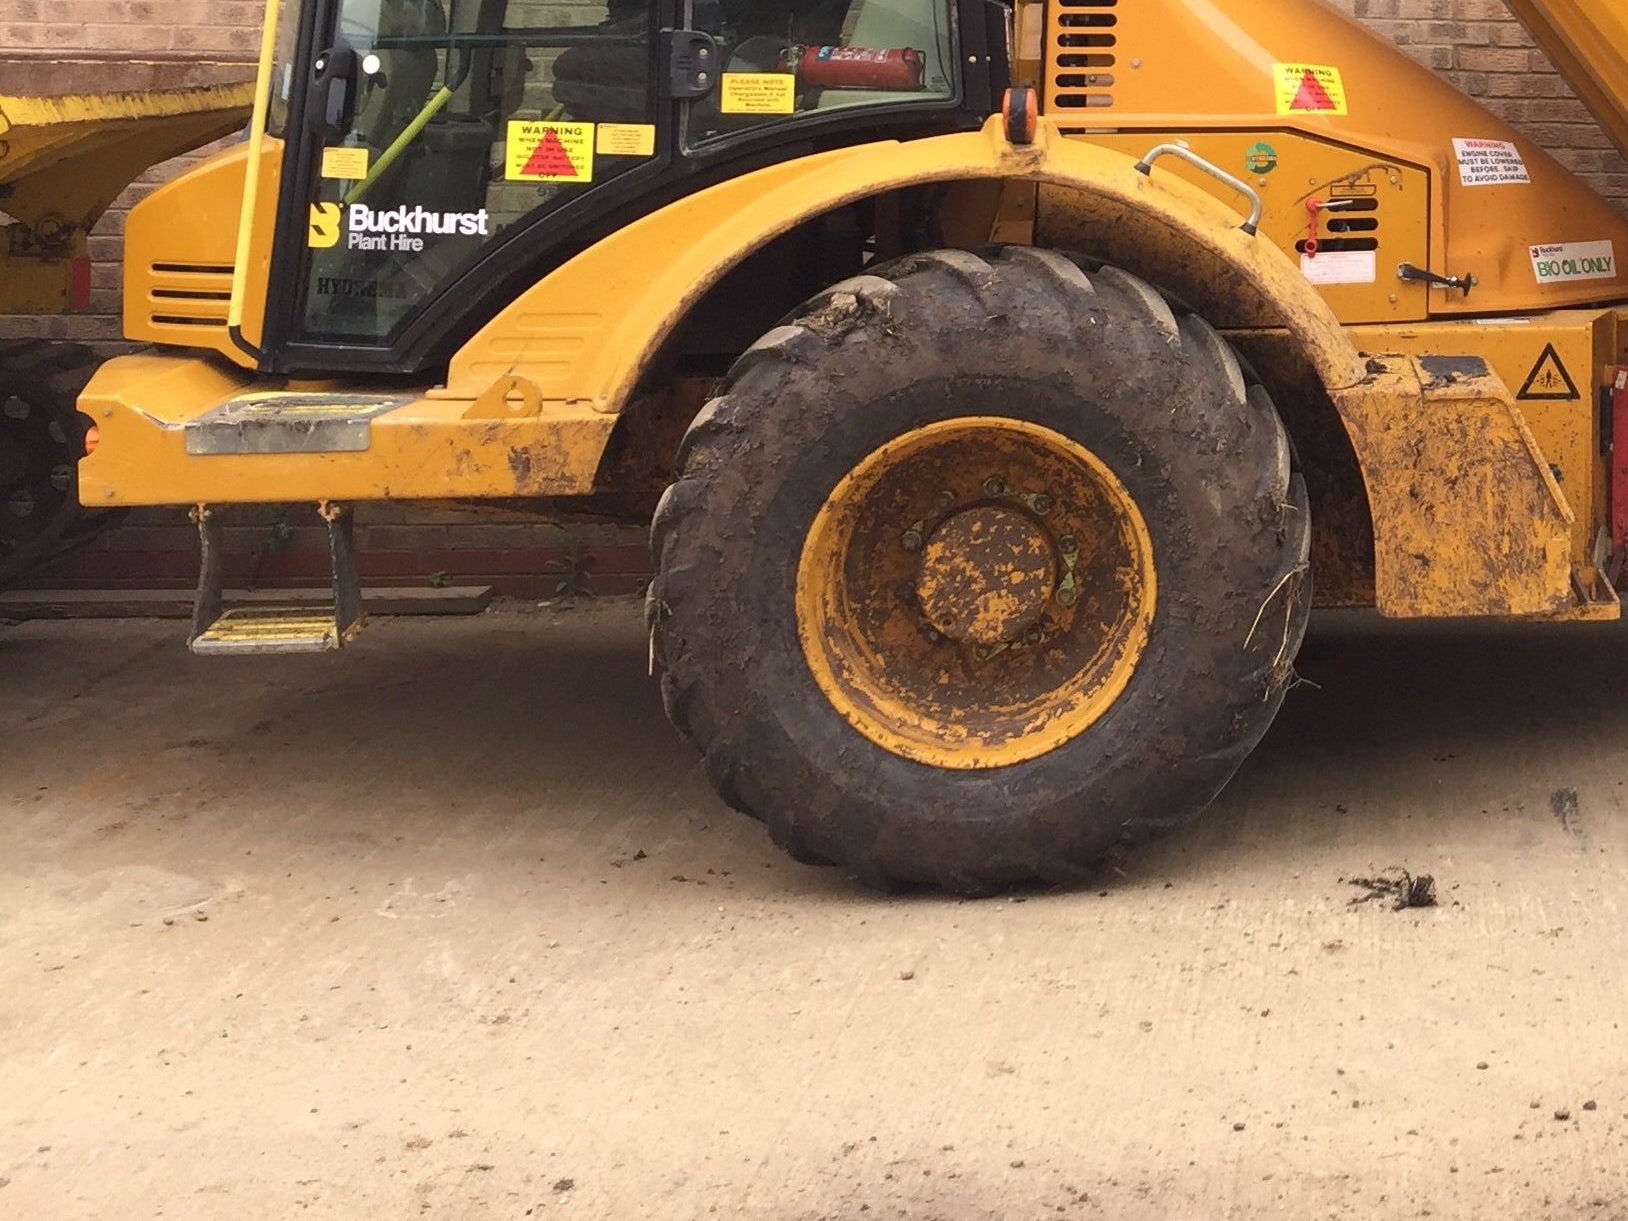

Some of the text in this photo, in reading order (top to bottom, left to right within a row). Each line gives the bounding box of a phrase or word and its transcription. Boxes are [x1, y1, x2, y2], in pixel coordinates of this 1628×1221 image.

[521, 126, 583, 136] WARNING
[349, 203, 489, 235] Buckhurst
[348, 233, 424, 252] Plant Hire
[1536, 256, 1612, 277] BIO OIL ONLY
